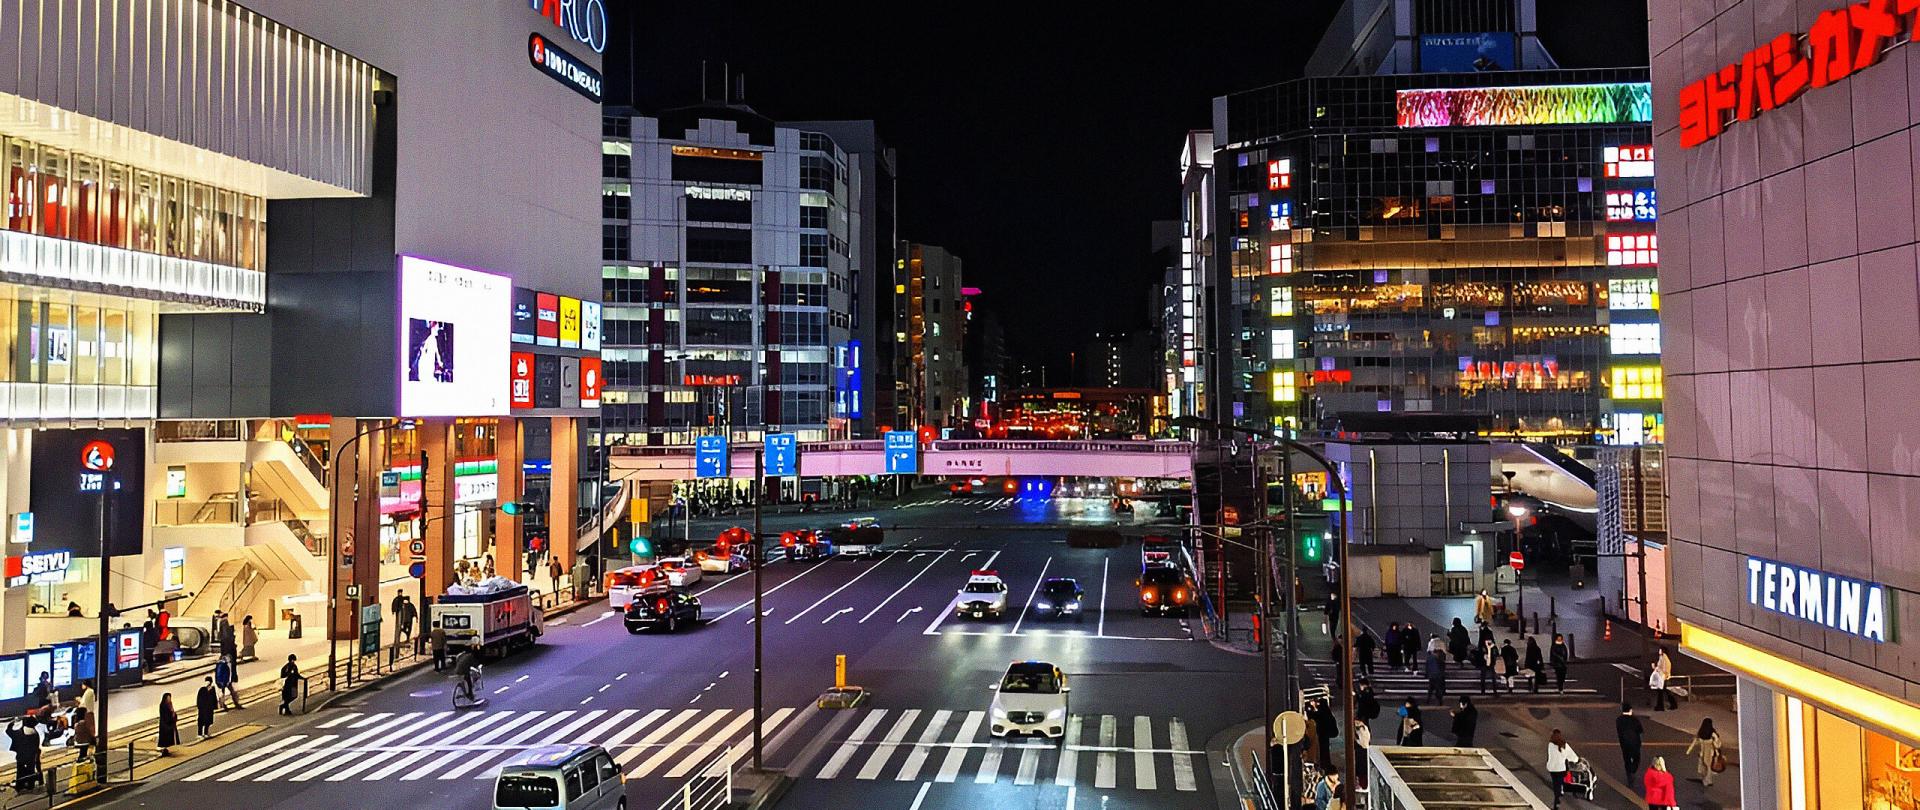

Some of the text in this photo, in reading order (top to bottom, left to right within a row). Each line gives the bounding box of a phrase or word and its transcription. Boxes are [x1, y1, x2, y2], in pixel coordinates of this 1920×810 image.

[533, 0, 606, 53] RCO
[22, 551, 70, 576] SEIYU
[1748, 558, 1884, 642] TERMINA
